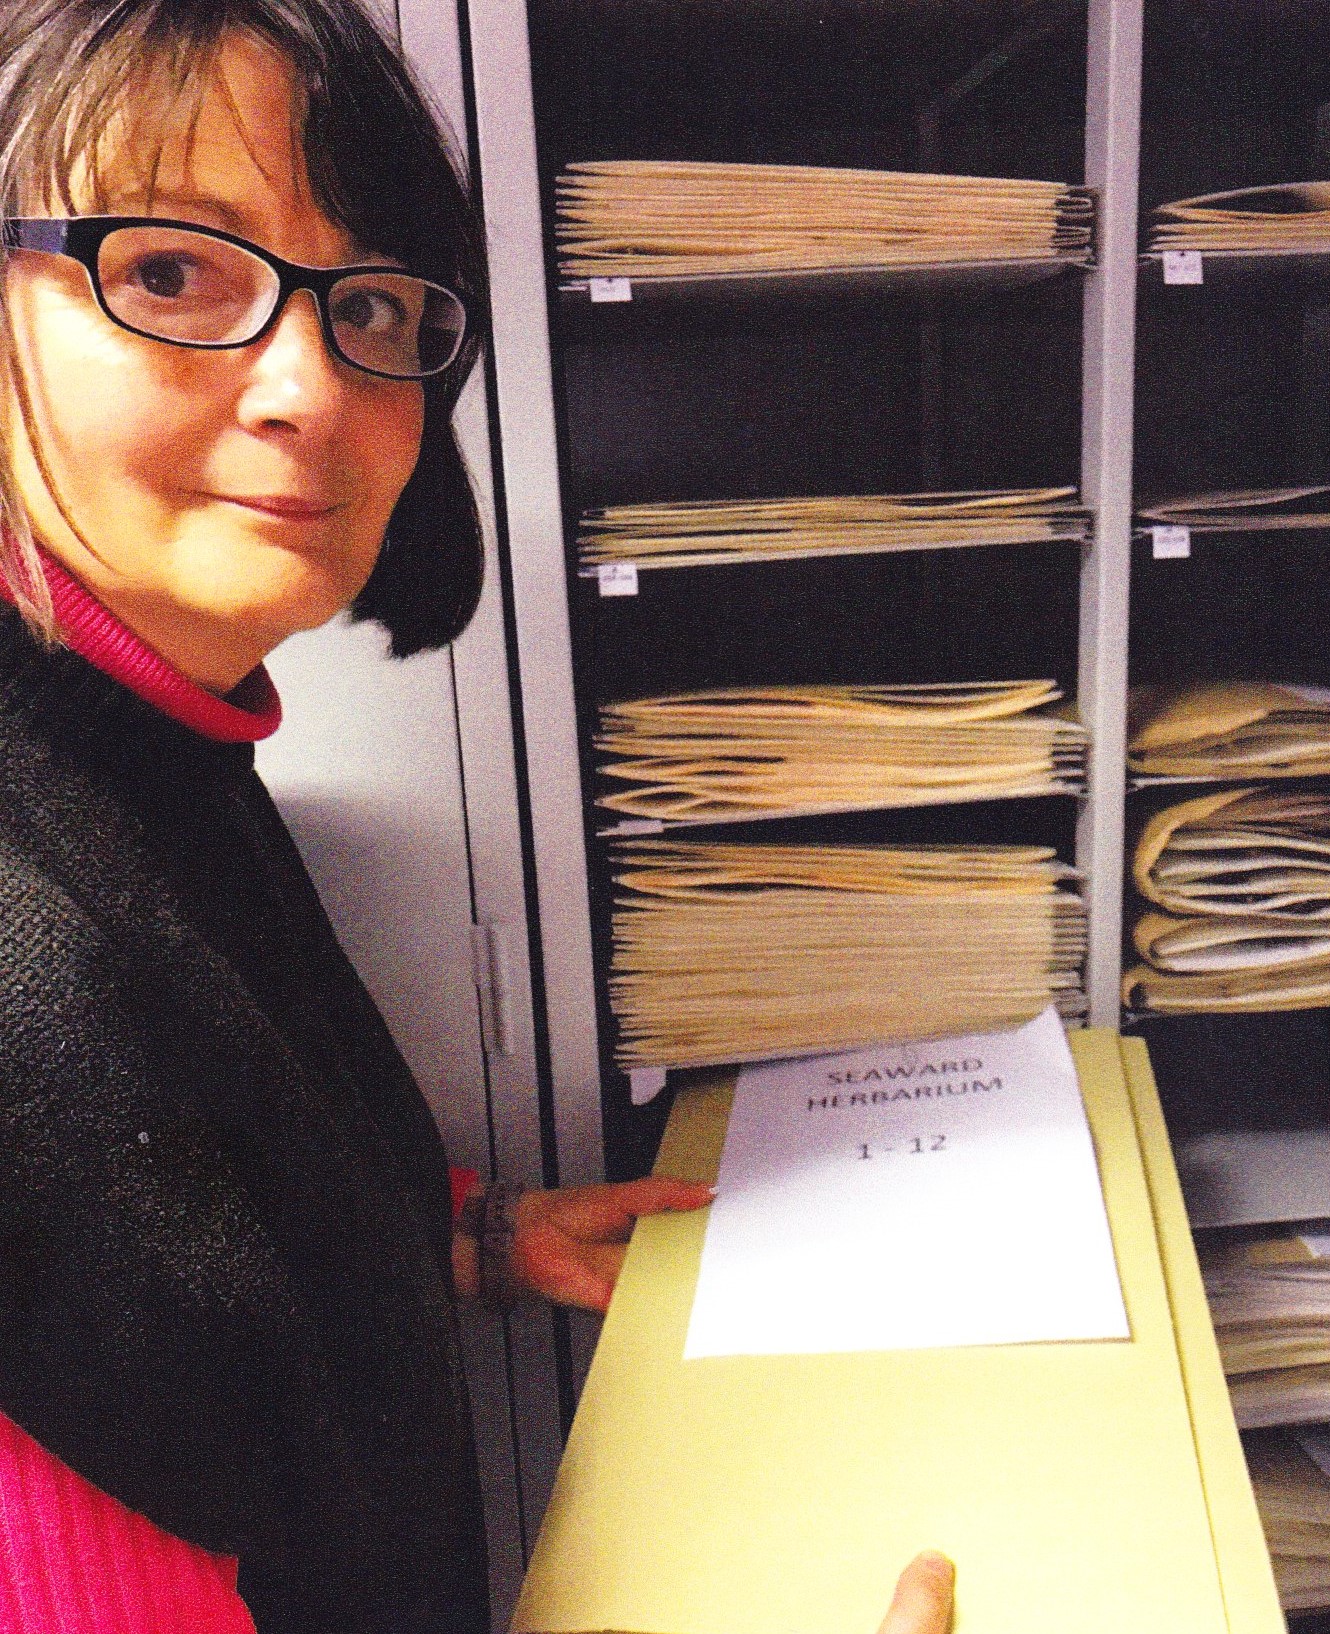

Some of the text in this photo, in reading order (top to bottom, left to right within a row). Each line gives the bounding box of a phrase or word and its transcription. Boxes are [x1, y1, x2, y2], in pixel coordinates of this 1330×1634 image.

[828, 1058, 983, 1085] SEAWARD
[808, 1077, 1003, 1111] HERBARIUM
[858, 1143, 871, 1160] 1
[911, 1134, 947, 1154] 12
